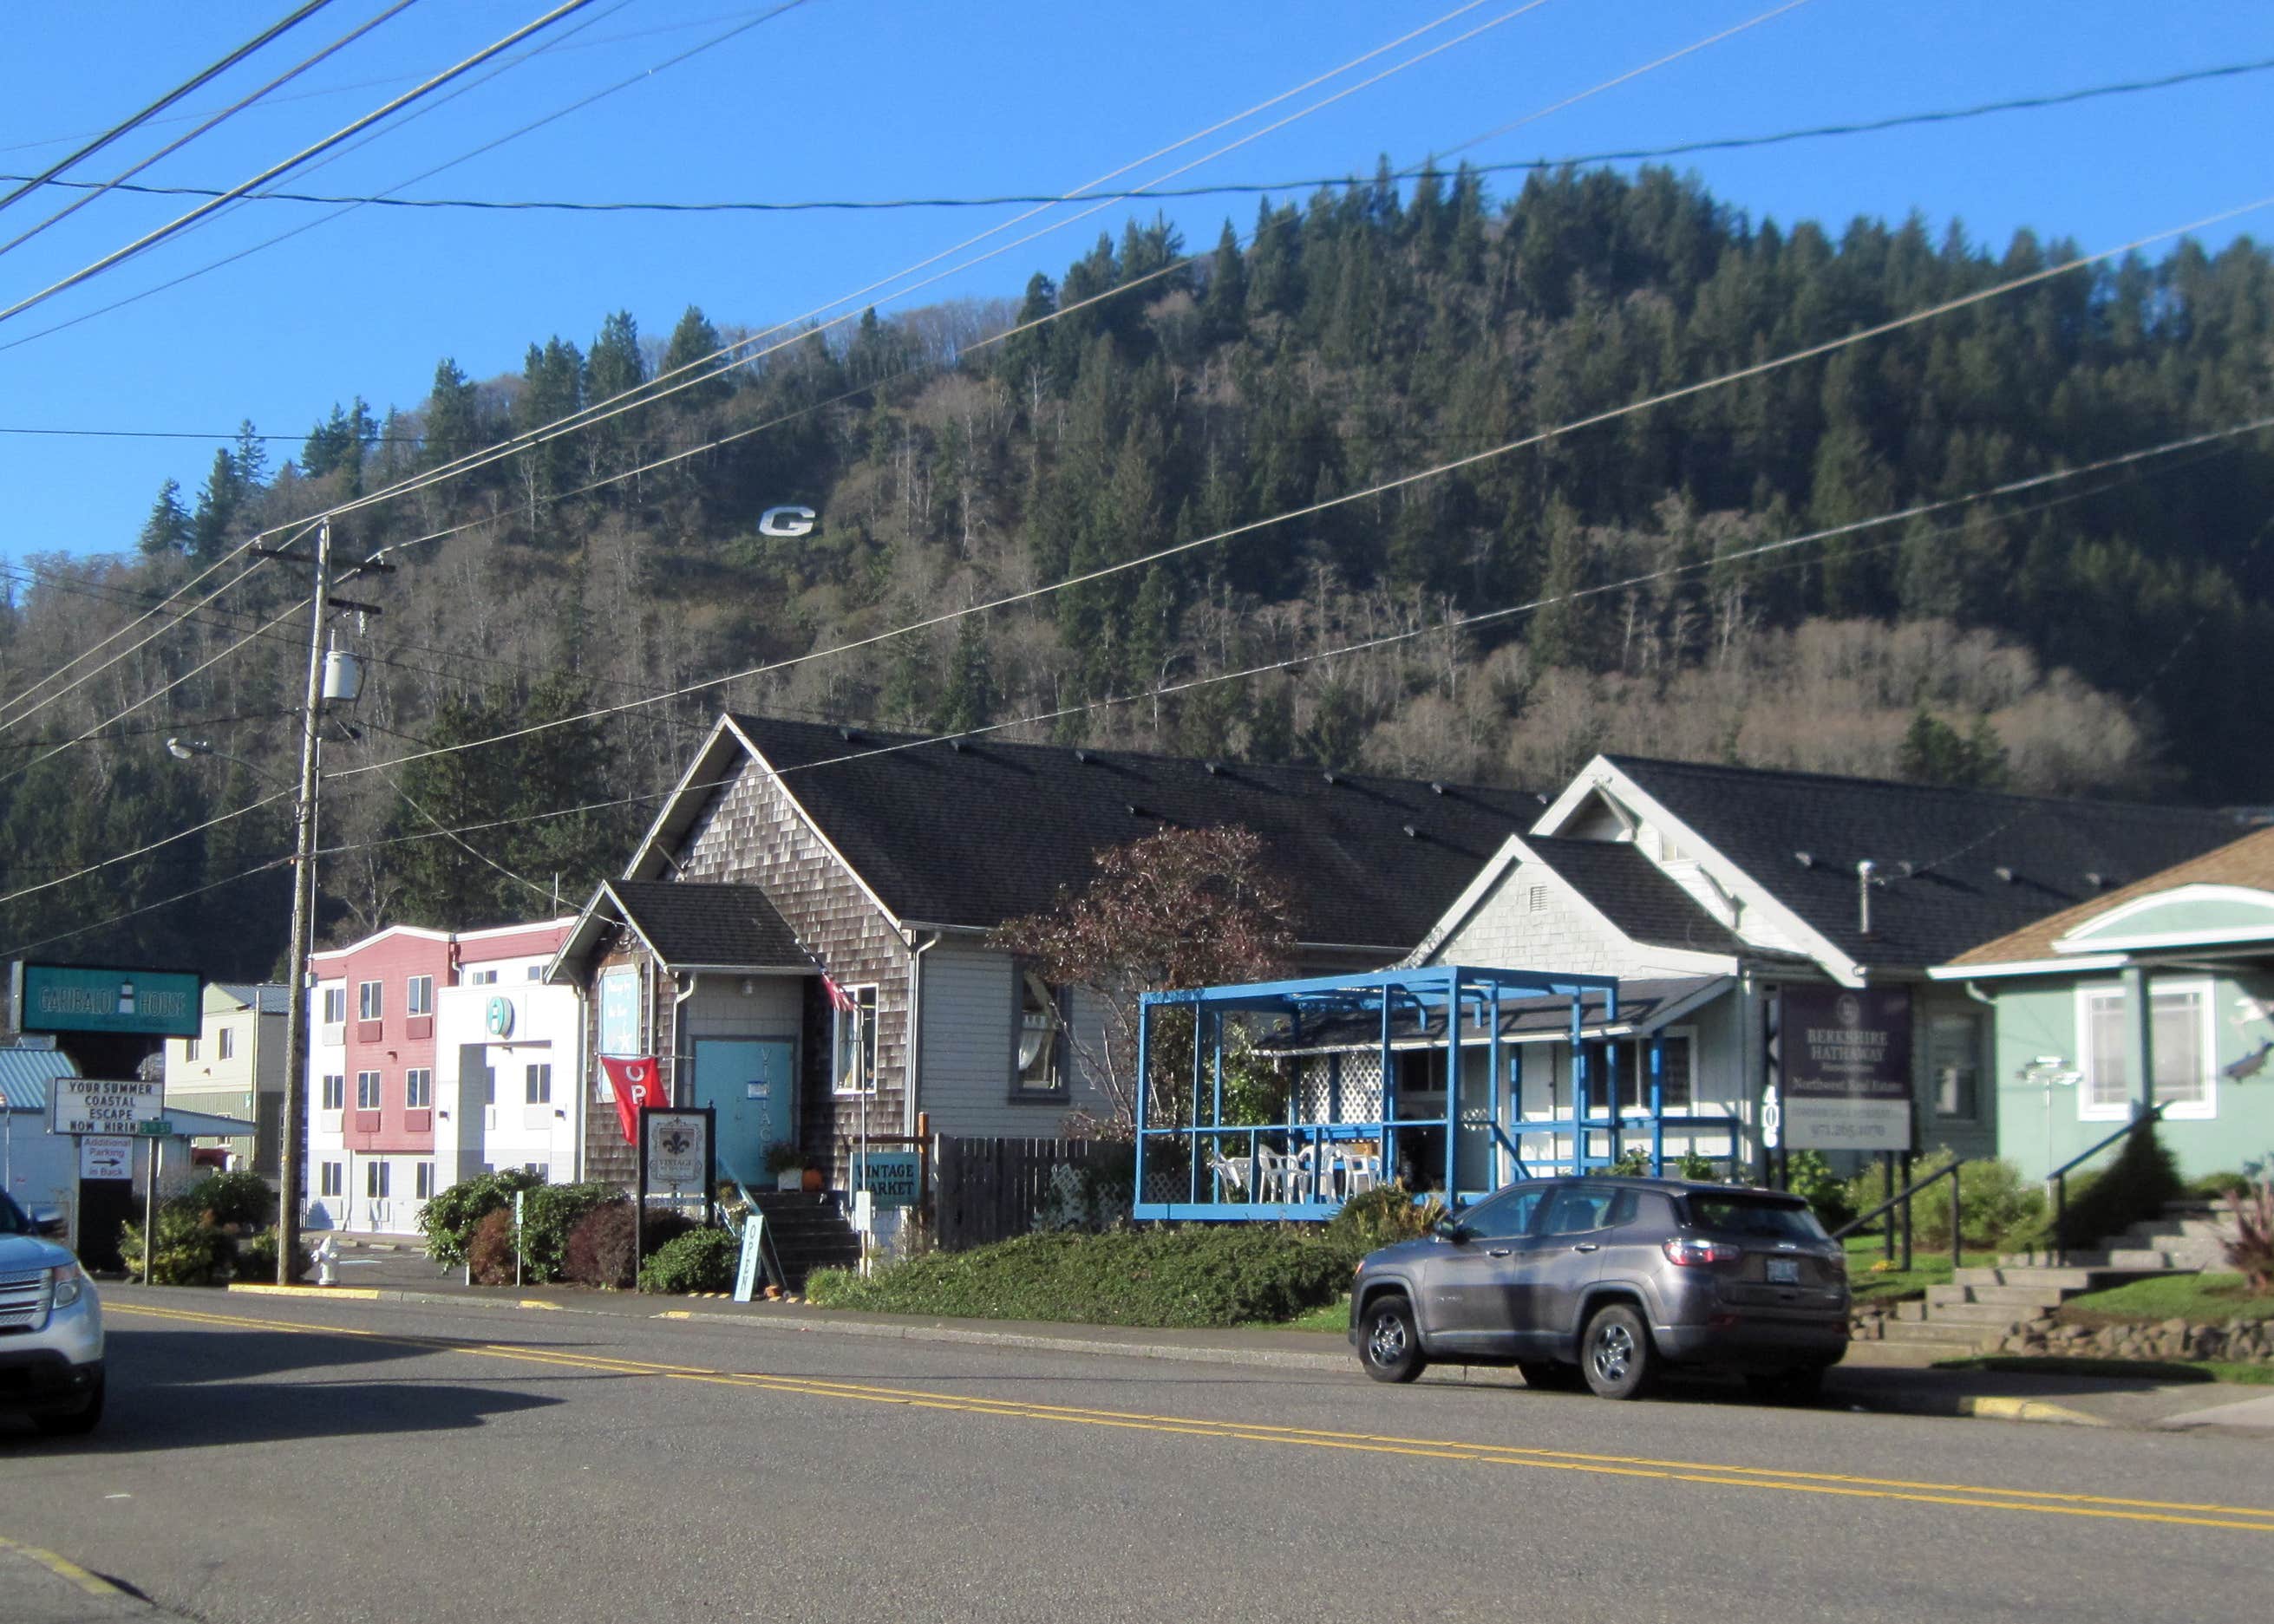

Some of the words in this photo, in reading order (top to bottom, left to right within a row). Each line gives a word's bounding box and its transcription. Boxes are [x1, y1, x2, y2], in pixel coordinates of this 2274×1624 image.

[40, 987, 115, 1014] GARIBALDI
[139, 991, 187, 1018] HOUSE
[1807, 1029, 1887, 1046] BERKSHIRE
[70, 1082, 100, 1092] YOUR
[104, 1083, 152, 1094] SUMMER
[85, 1096, 136, 1107] COASTAL
[89, 1109, 133, 1120] ESCAPE
[104, 1121, 138, 1134] HIRIN
[857, 1164, 914, 1178] VINTAGE
[741, 1223, 756, 1292] OPEN
